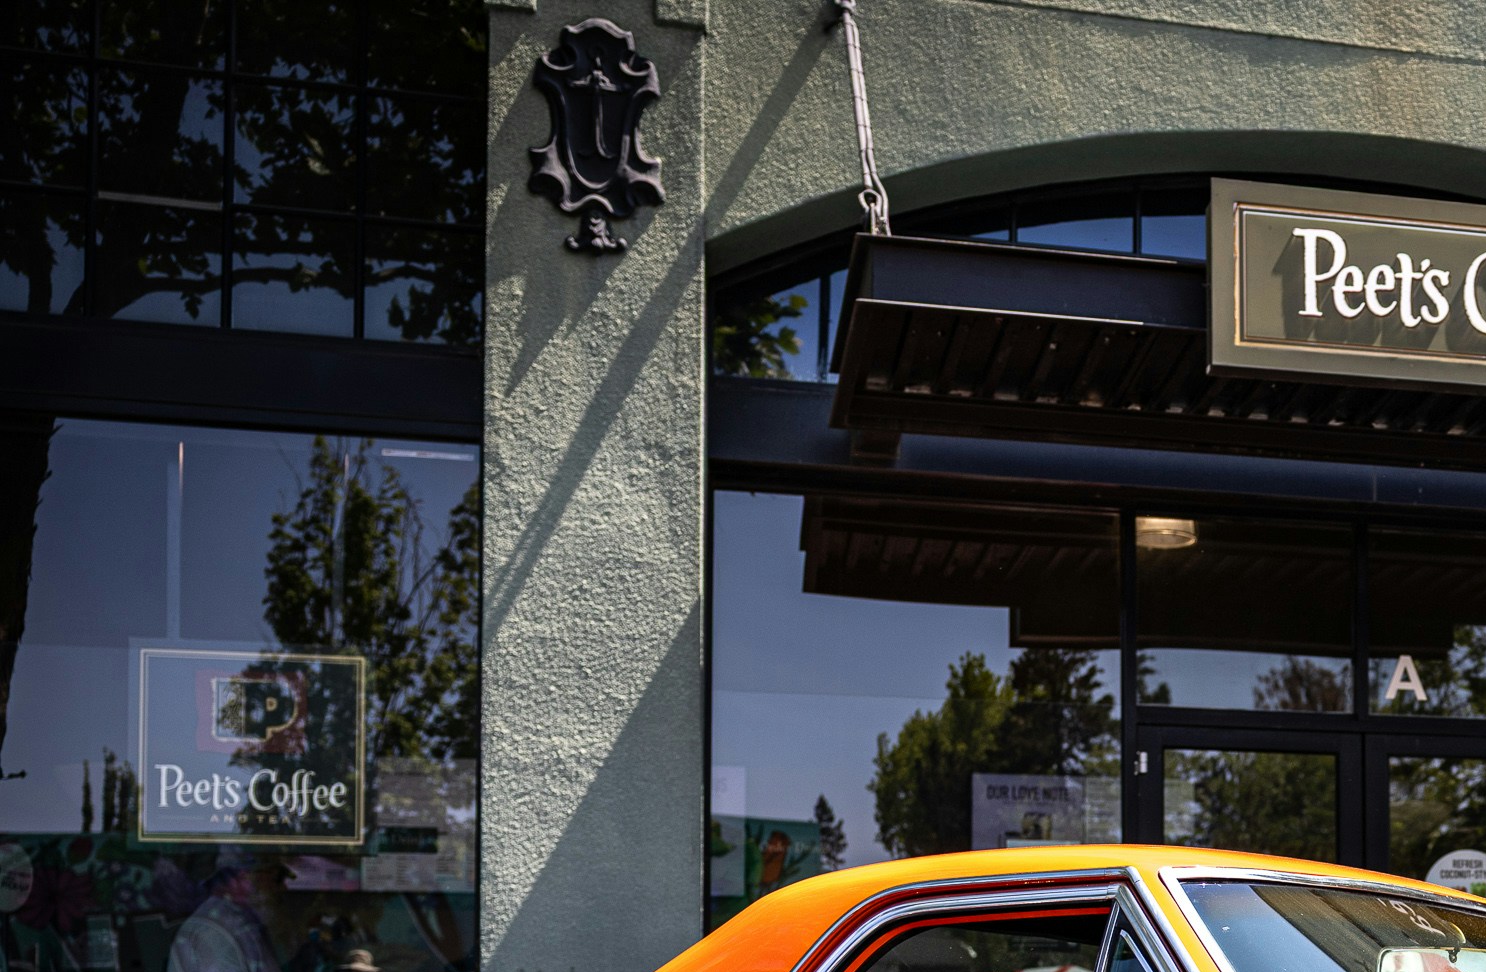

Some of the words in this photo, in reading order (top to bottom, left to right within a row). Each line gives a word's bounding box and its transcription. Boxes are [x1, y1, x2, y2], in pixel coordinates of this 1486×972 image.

[1293, 228, 1450, 328] Peet's
[1385, 655, 1427, 701] A
[154, 764, 241, 810] Peet's
[250, 768, 348, 816] Coffee
[210, 814, 248, 824] AND
[256, 814, 291, 824] TEA
[1452, 859, 1483, 868] REFRESH
